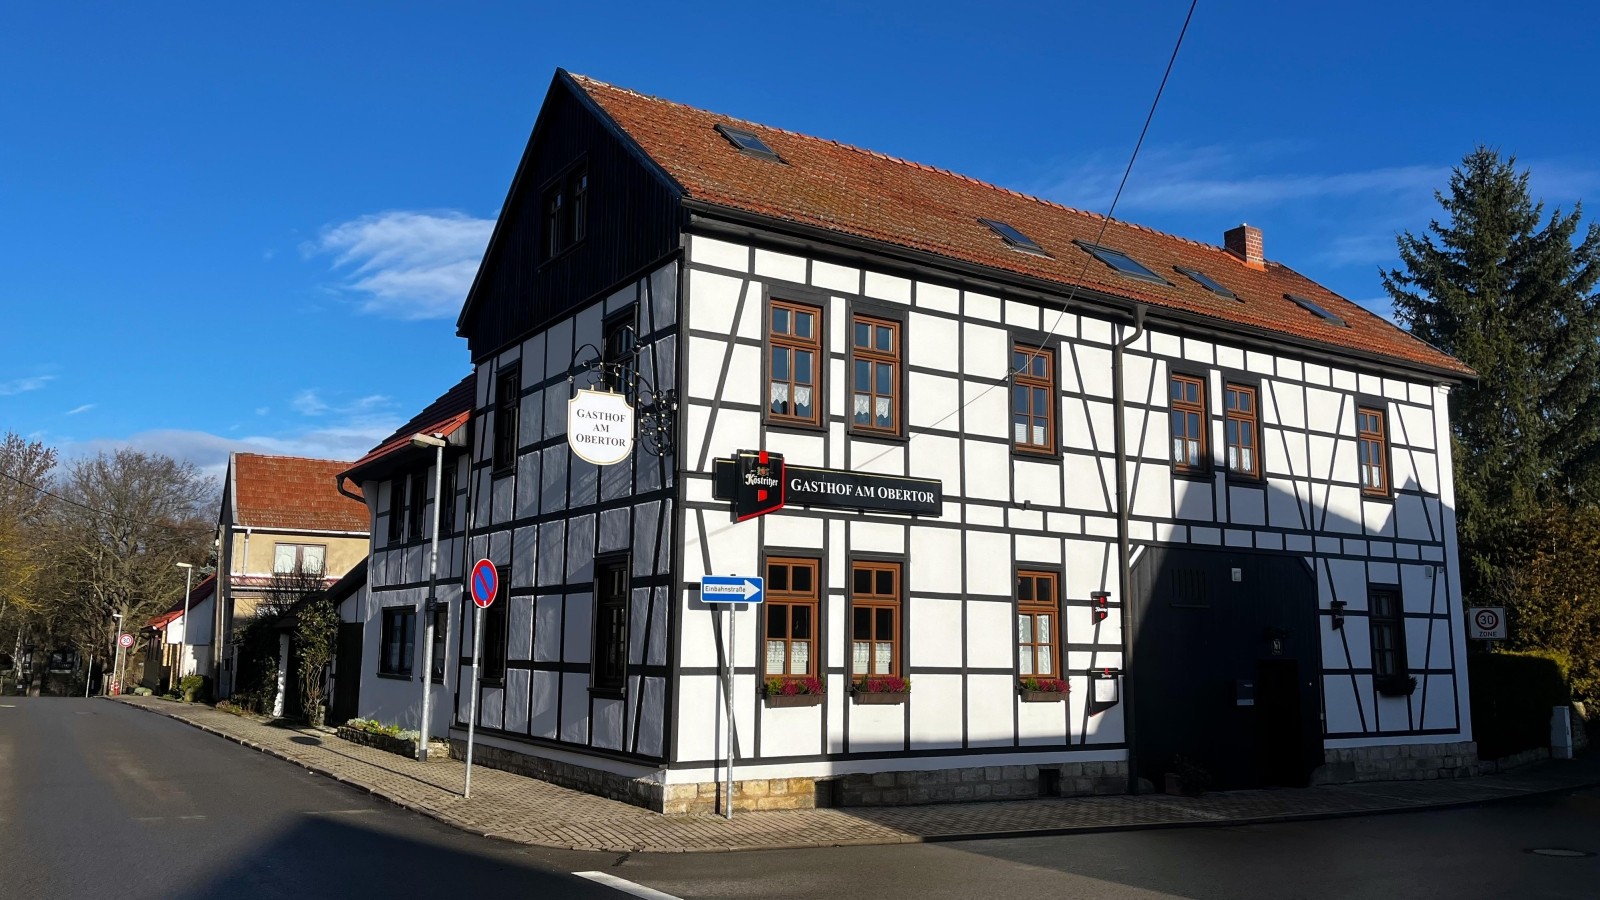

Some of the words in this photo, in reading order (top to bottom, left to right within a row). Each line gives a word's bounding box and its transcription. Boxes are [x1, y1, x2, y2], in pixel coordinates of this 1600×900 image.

[576, 408, 626, 423] GASTHOF
[593, 423, 609, 433] AM
[575, 433, 626, 447] OBERTOR
[744, 473, 779, 488] Köstritzer
[790, 478, 854, 496] GASTHOF
[854, 485, 875, 498] AM
[877, 486, 935, 504] OBERTOR
[705, 585, 746, 593] Einbahnstraße
[1479, 614, 1494, 625] 30
